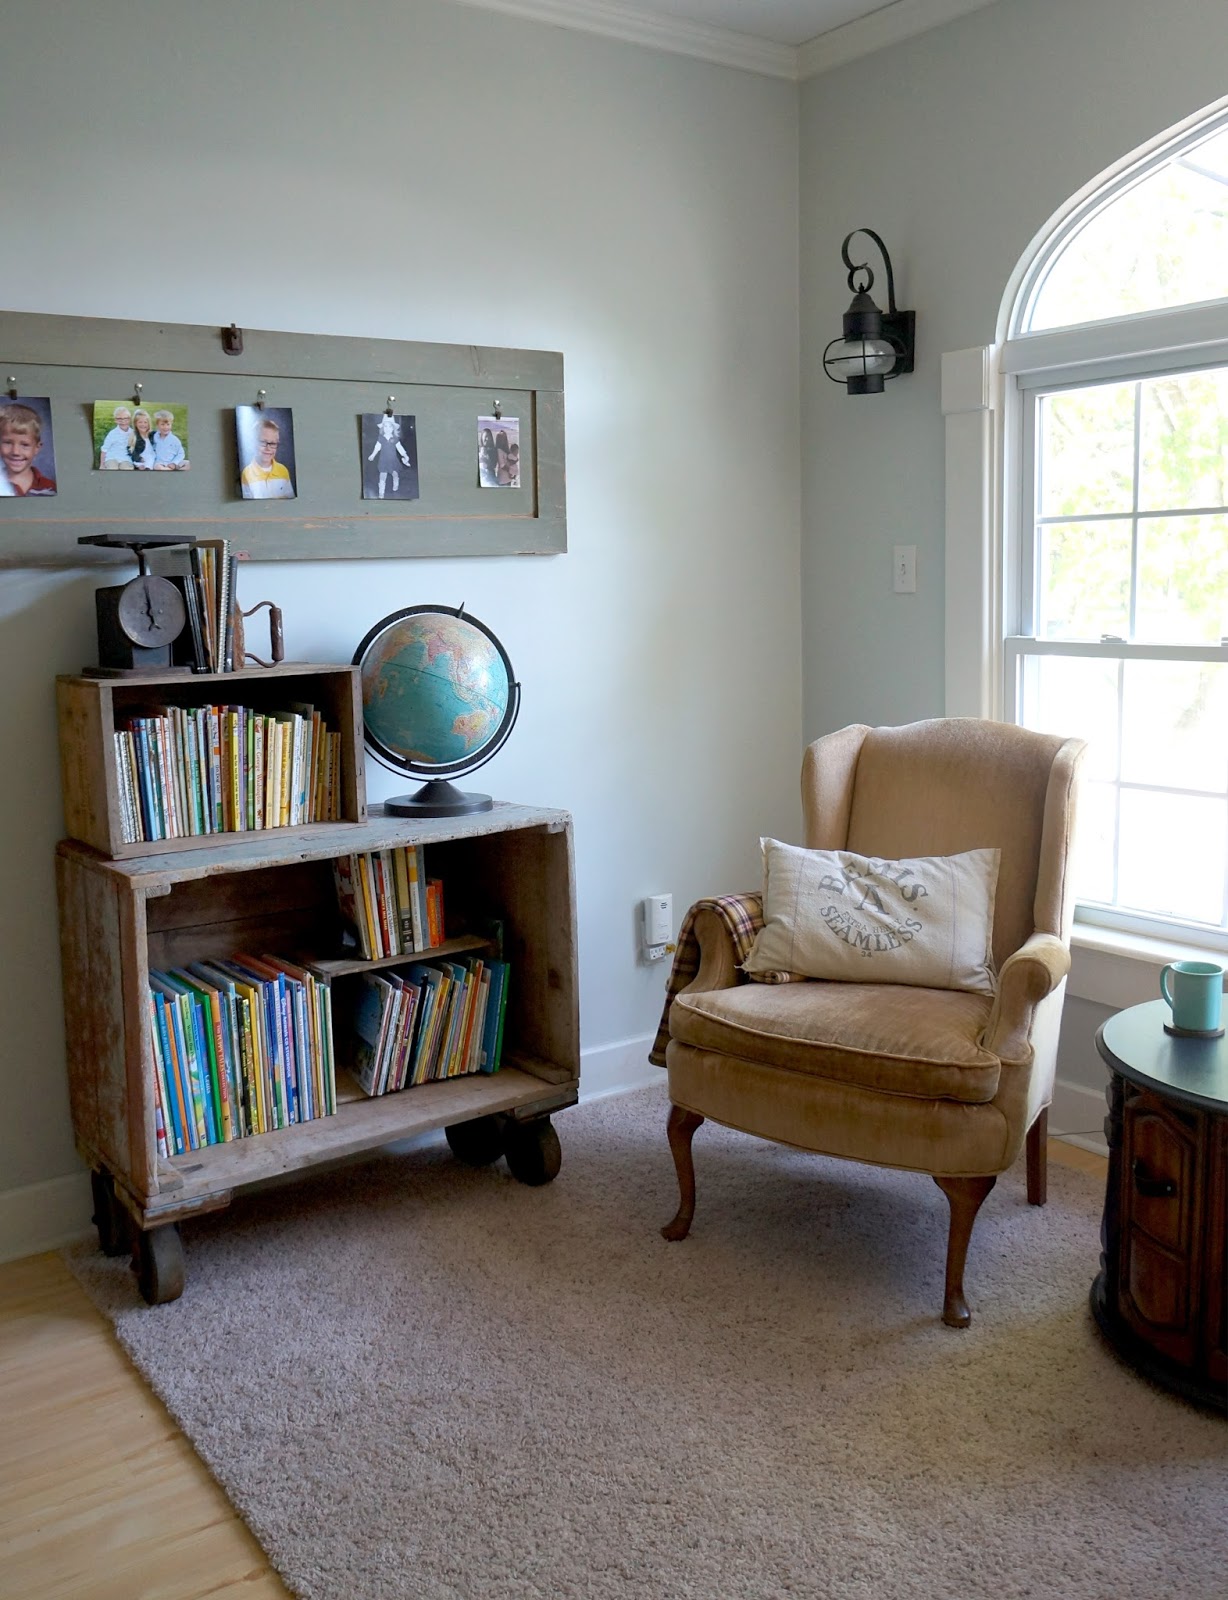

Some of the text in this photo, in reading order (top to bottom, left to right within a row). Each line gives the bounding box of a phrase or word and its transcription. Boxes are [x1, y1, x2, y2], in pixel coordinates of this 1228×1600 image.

[818, 862, 929, 902] BEMIS
[385, 895, 393, 915] Nature's
[853, 883, 890, 915] A
[819, 905, 923, 952] SEAMLESS
[841, 911, 868, 932] EXTRA
[215, 1033, 223, 1053] PUPPY
[284, 1037, 289, 1046] CD
